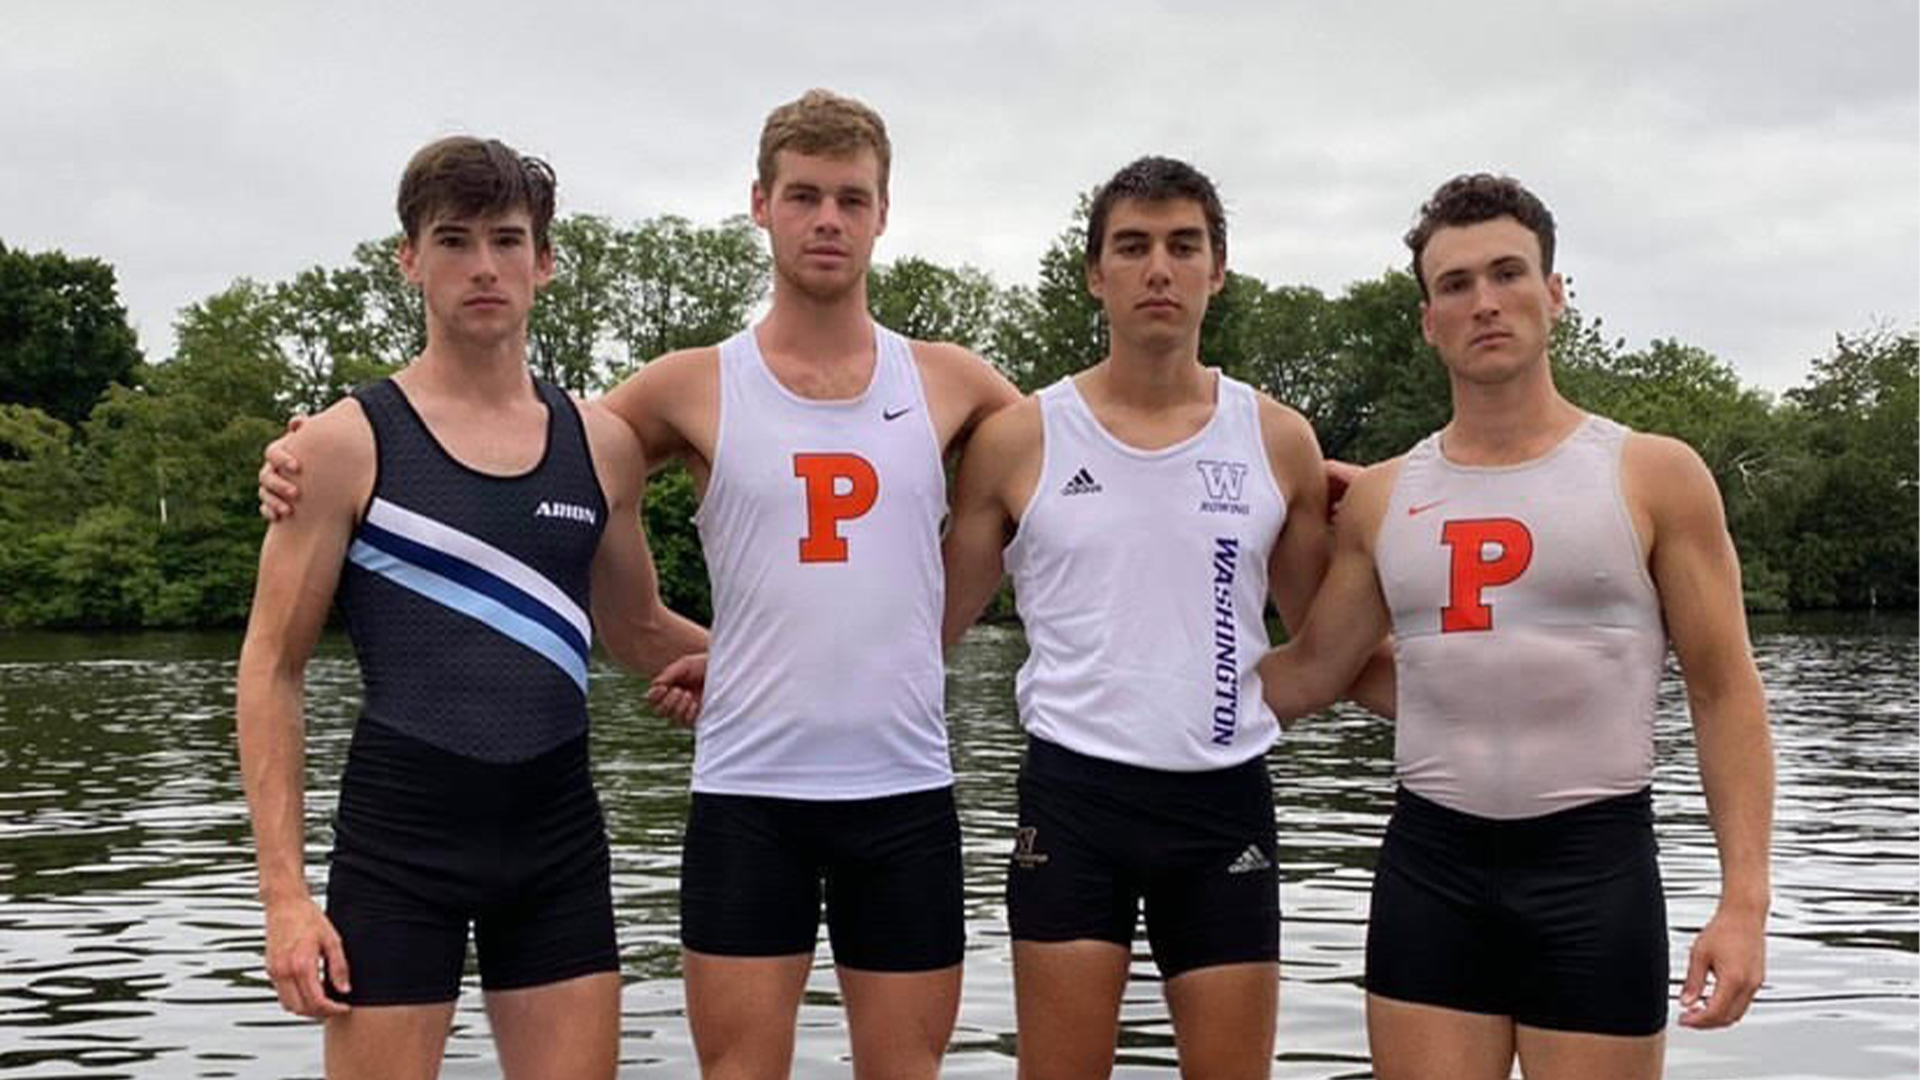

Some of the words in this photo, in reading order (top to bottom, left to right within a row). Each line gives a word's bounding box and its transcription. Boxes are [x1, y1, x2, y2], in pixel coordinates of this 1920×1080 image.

[535, 501, 596, 524] ARION
[793, 453, 879, 563] P
[1196, 460, 1248, 500] W
[1200, 501, 1250, 515] ROWING
[1440, 517, 1534, 633] P
[1212, 537, 1239, 746] WASHINGTON
